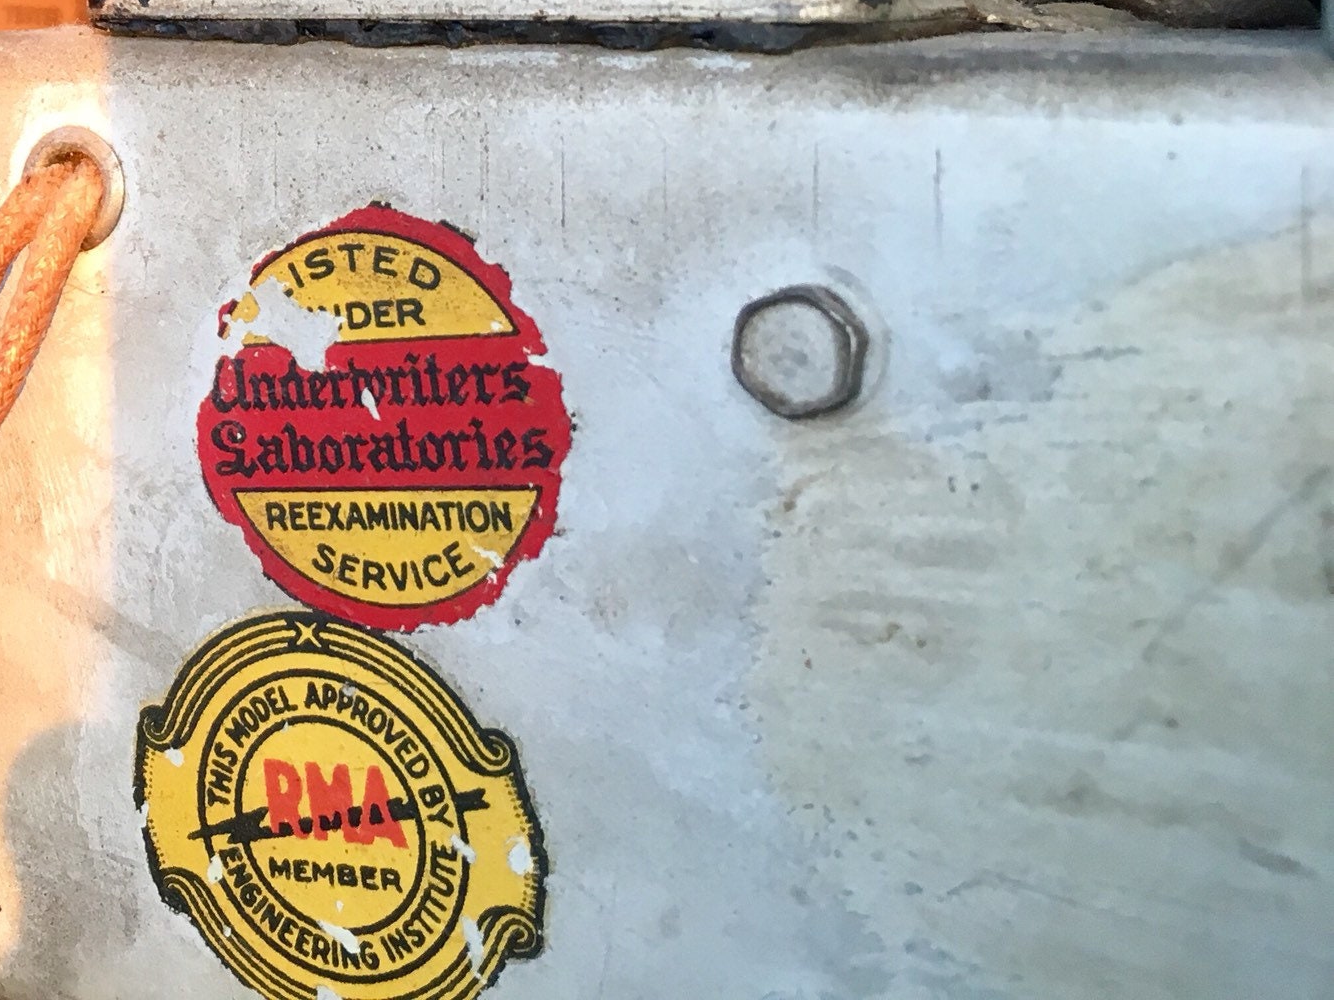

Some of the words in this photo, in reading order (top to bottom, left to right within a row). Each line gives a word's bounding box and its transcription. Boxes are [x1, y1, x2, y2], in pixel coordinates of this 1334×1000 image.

[284, 243, 441, 297] ISTED
[307, 298, 426, 331] DER
[211, 353, 532, 413] Underwriters
[211, 415, 554, 477] Laboratories
[266, 500, 513, 532] REEXAMINATION
[311, 540, 475, 592] SERVICE
[206, 742, 238, 806] THIS
[225, 685, 298, 748] MODEL
[304, 681, 430, 779] APPROVED
[418, 784, 454, 828] BY
[263, 758, 409, 849] RMA
[268, 856, 403, 894] MEMBER
[218, 846, 381, 970] ENGINEERING
[380, 840, 457, 962] INSTITUTE
